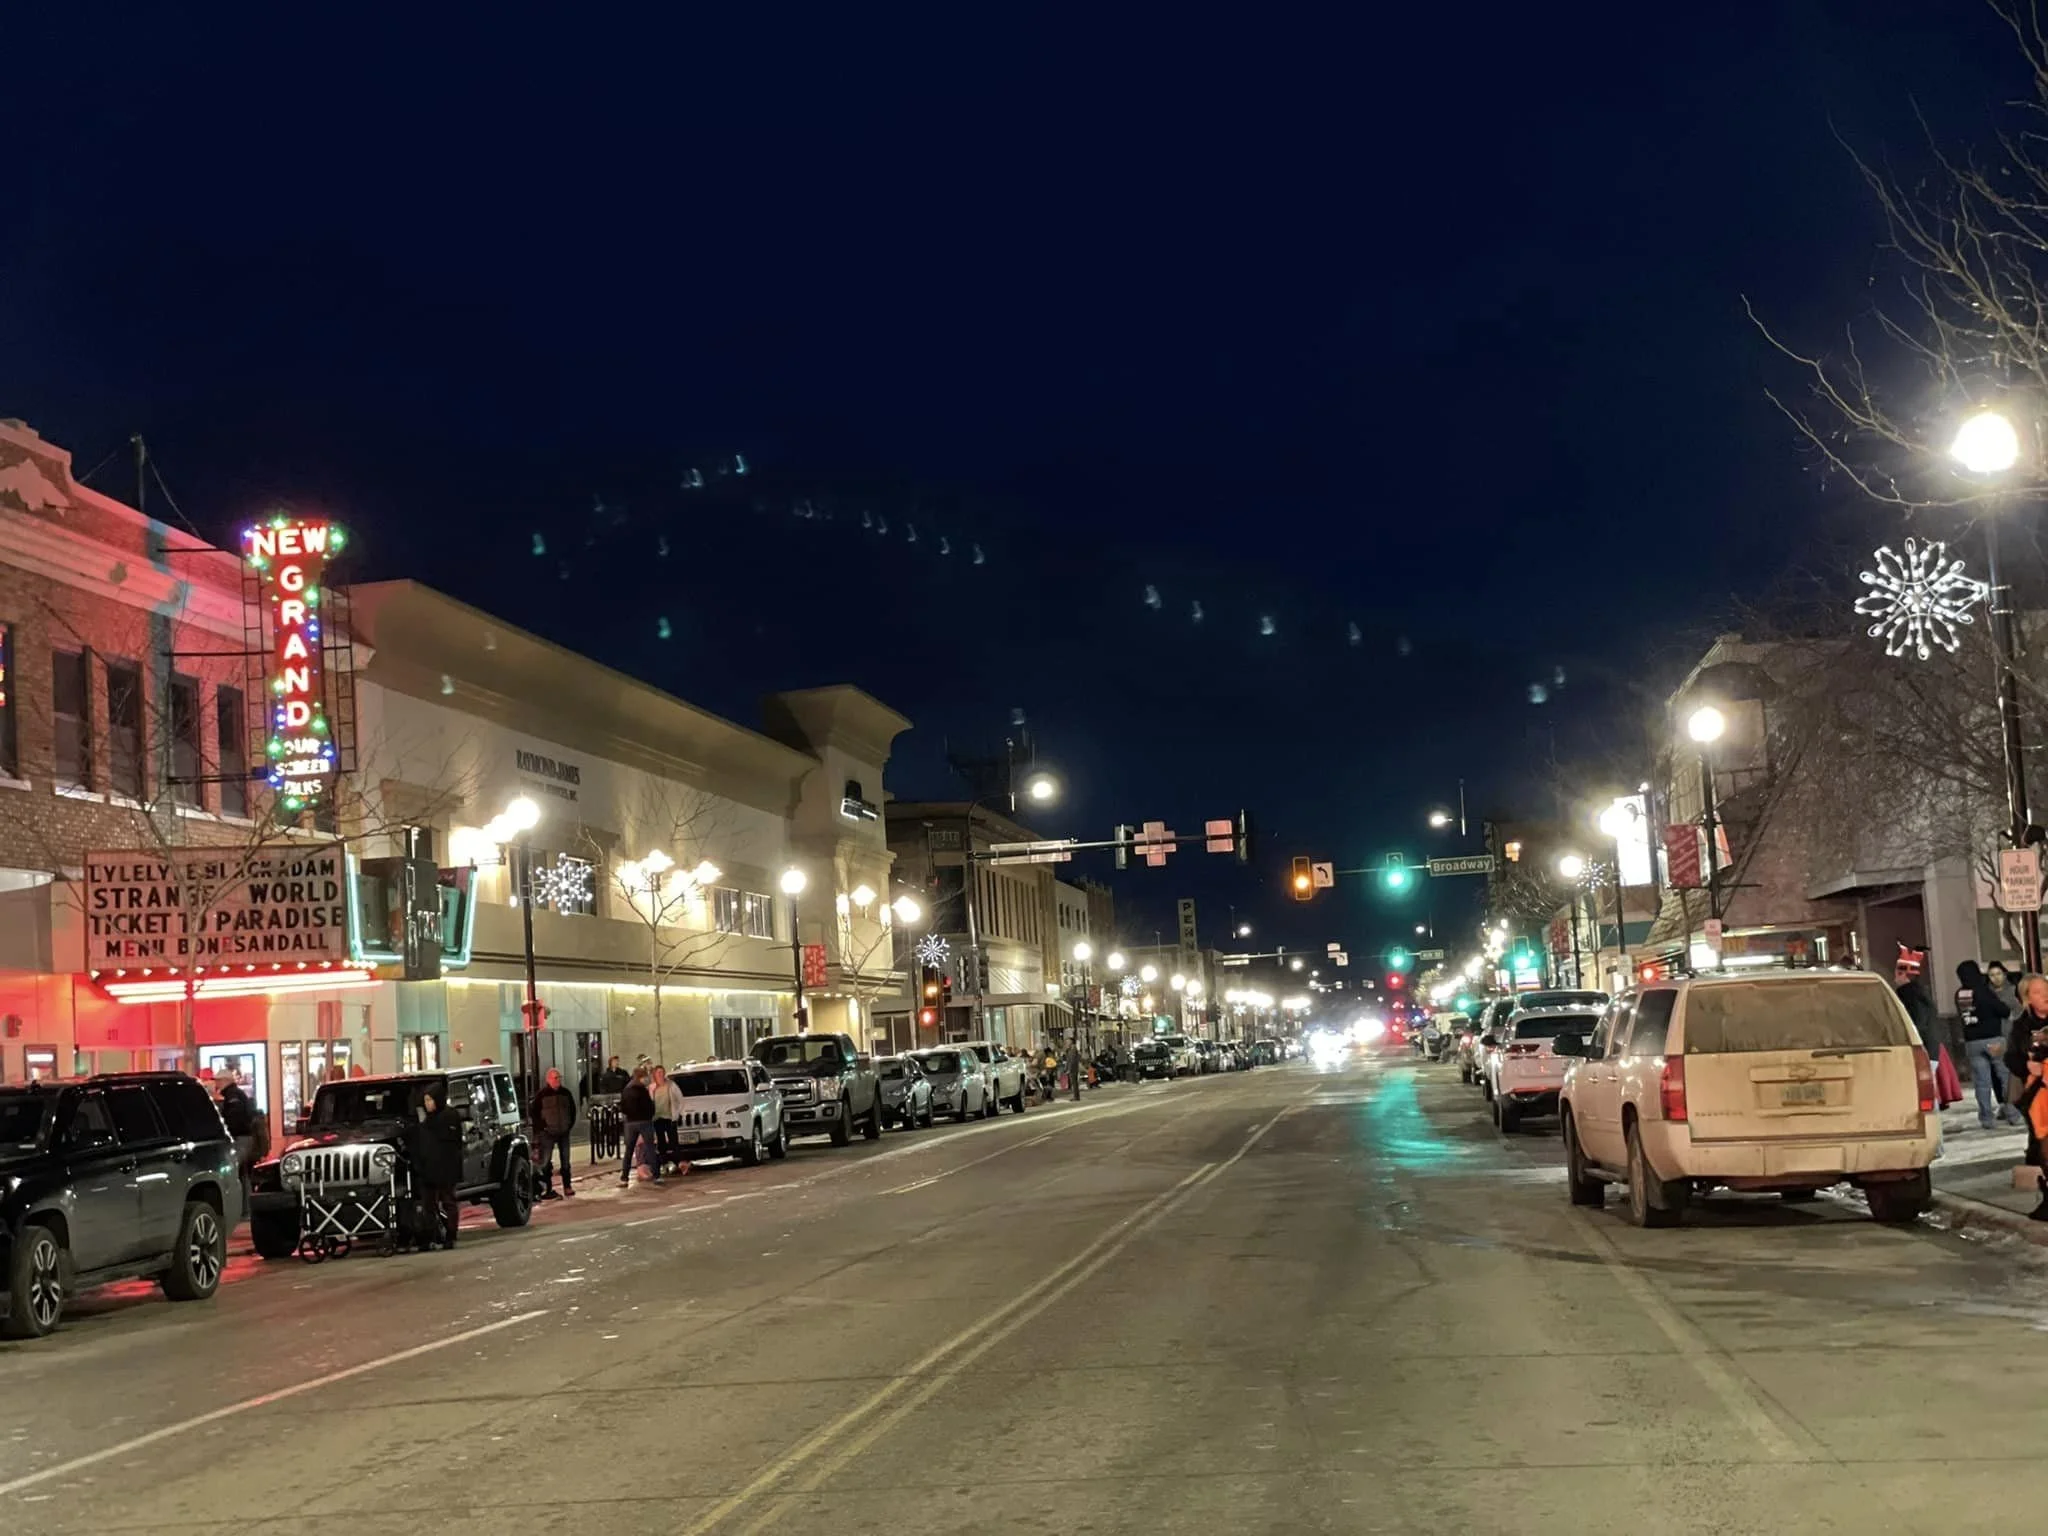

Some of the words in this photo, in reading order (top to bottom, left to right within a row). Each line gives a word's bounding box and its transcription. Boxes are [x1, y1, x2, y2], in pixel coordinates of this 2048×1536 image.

[252, 527, 327, 557] NEW
[280, 565, 311, 727] GRAND
[277, 859, 335, 877] ADAM
[1433, 860, 1491, 872] Broadway
[249, 880, 338, 904] WORLD
[90, 912, 171, 935] TICKET
[216, 906, 343, 931] PARADISE
[106, 939, 164, 957] MENU
